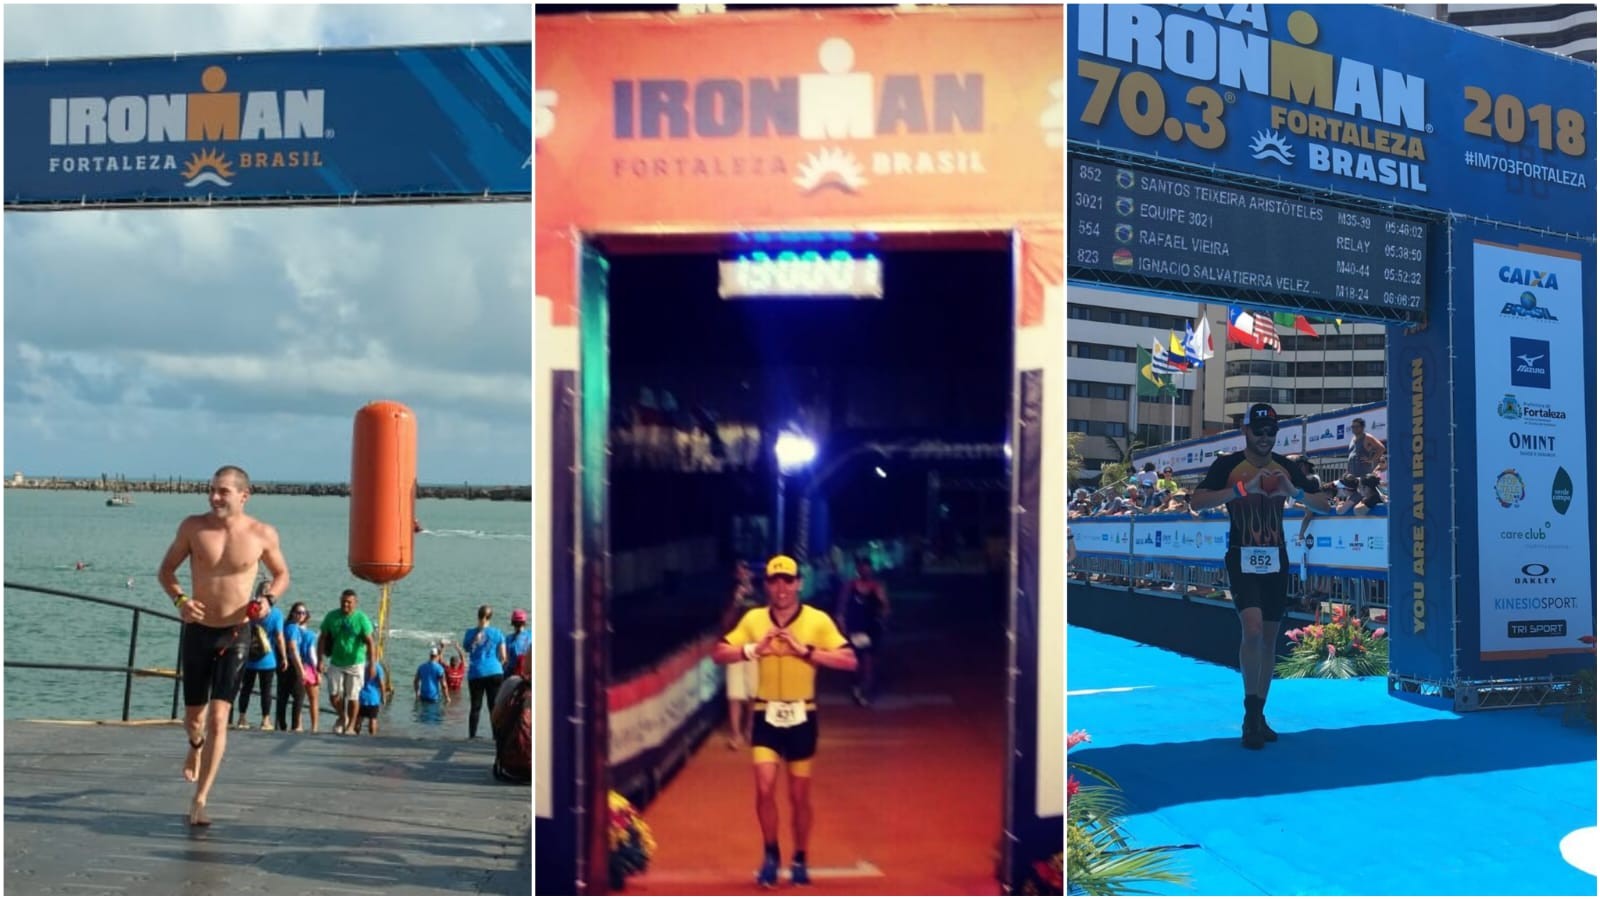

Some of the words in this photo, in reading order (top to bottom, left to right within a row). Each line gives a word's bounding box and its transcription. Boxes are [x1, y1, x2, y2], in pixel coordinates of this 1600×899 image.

[612, 70, 986, 139] IRONMAN
[1463, 86, 1586, 157] 2018
[1270, 104, 1425, 161] FORTALEZA
[50, 155, 177, 172] FORTALEZA
[239, 151, 323, 168] BRASIL
[613, 156, 787, 177] FORTALEZA
[872, 151, 988, 175] BRASIL
[1309, 143, 1427, 192] BRASIL
[1464, 150, 1586, 189] #IM703FORTALEZA
[1079, 165, 1101, 182] 852
[1140, 177, 1191, 198] SANTOS
[1195, 187, 1247, 208] TEIXEIRA
[1249, 197, 1323, 221] ARISTÓTELES
[1338, 212, 1371, 229] M35-39
[1075, 192, 1102, 210] 3021
[1140, 203, 1185, 225] EQUIPE
[1189, 211, 1214, 229] 3021
[1337, 236, 1371, 254] RELAY
[1078, 220, 1100, 236] 554
[1139, 230, 1188, 250] RAFAEL
[1191, 238, 1230, 256] VIEIRA
[1336, 260, 1370, 278] M40-44
[1384, 268, 1422, 286] 05:52:32
[1077, 248, 1100, 264] 823
[1138, 257, 1191, 277] IGNACIO
[1193, 265, 1273, 288] SALVATIERRA
[1276, 277, 1311, 294] VELEZ
[1336, 284, 1369, 301] M18-24
[1498, 265, 1559, 291] CAIXA
[1501, 302, 1559, 322] BRASIL
[1411, 357, 1424, 478] IRONMAN
[1523, 406, 1566, 420] Fortaleza
[1509, 432, 1556, 451] OMINT
[1412, 484, 1424, 521] AN
[1413, 525, 1425, 577] ARE
[1500, 530, 1523, 540] care
[1524, 528, 1546, 540] club
[1250, 555, 1272, 566] 852
[1514, 577, 1557, 585] OAKLEY
[1413, 581, 1425, 634] YOU
[1511, 624, 1528, 634] TRI
[1529, 623, 1564, 633] SPORT
